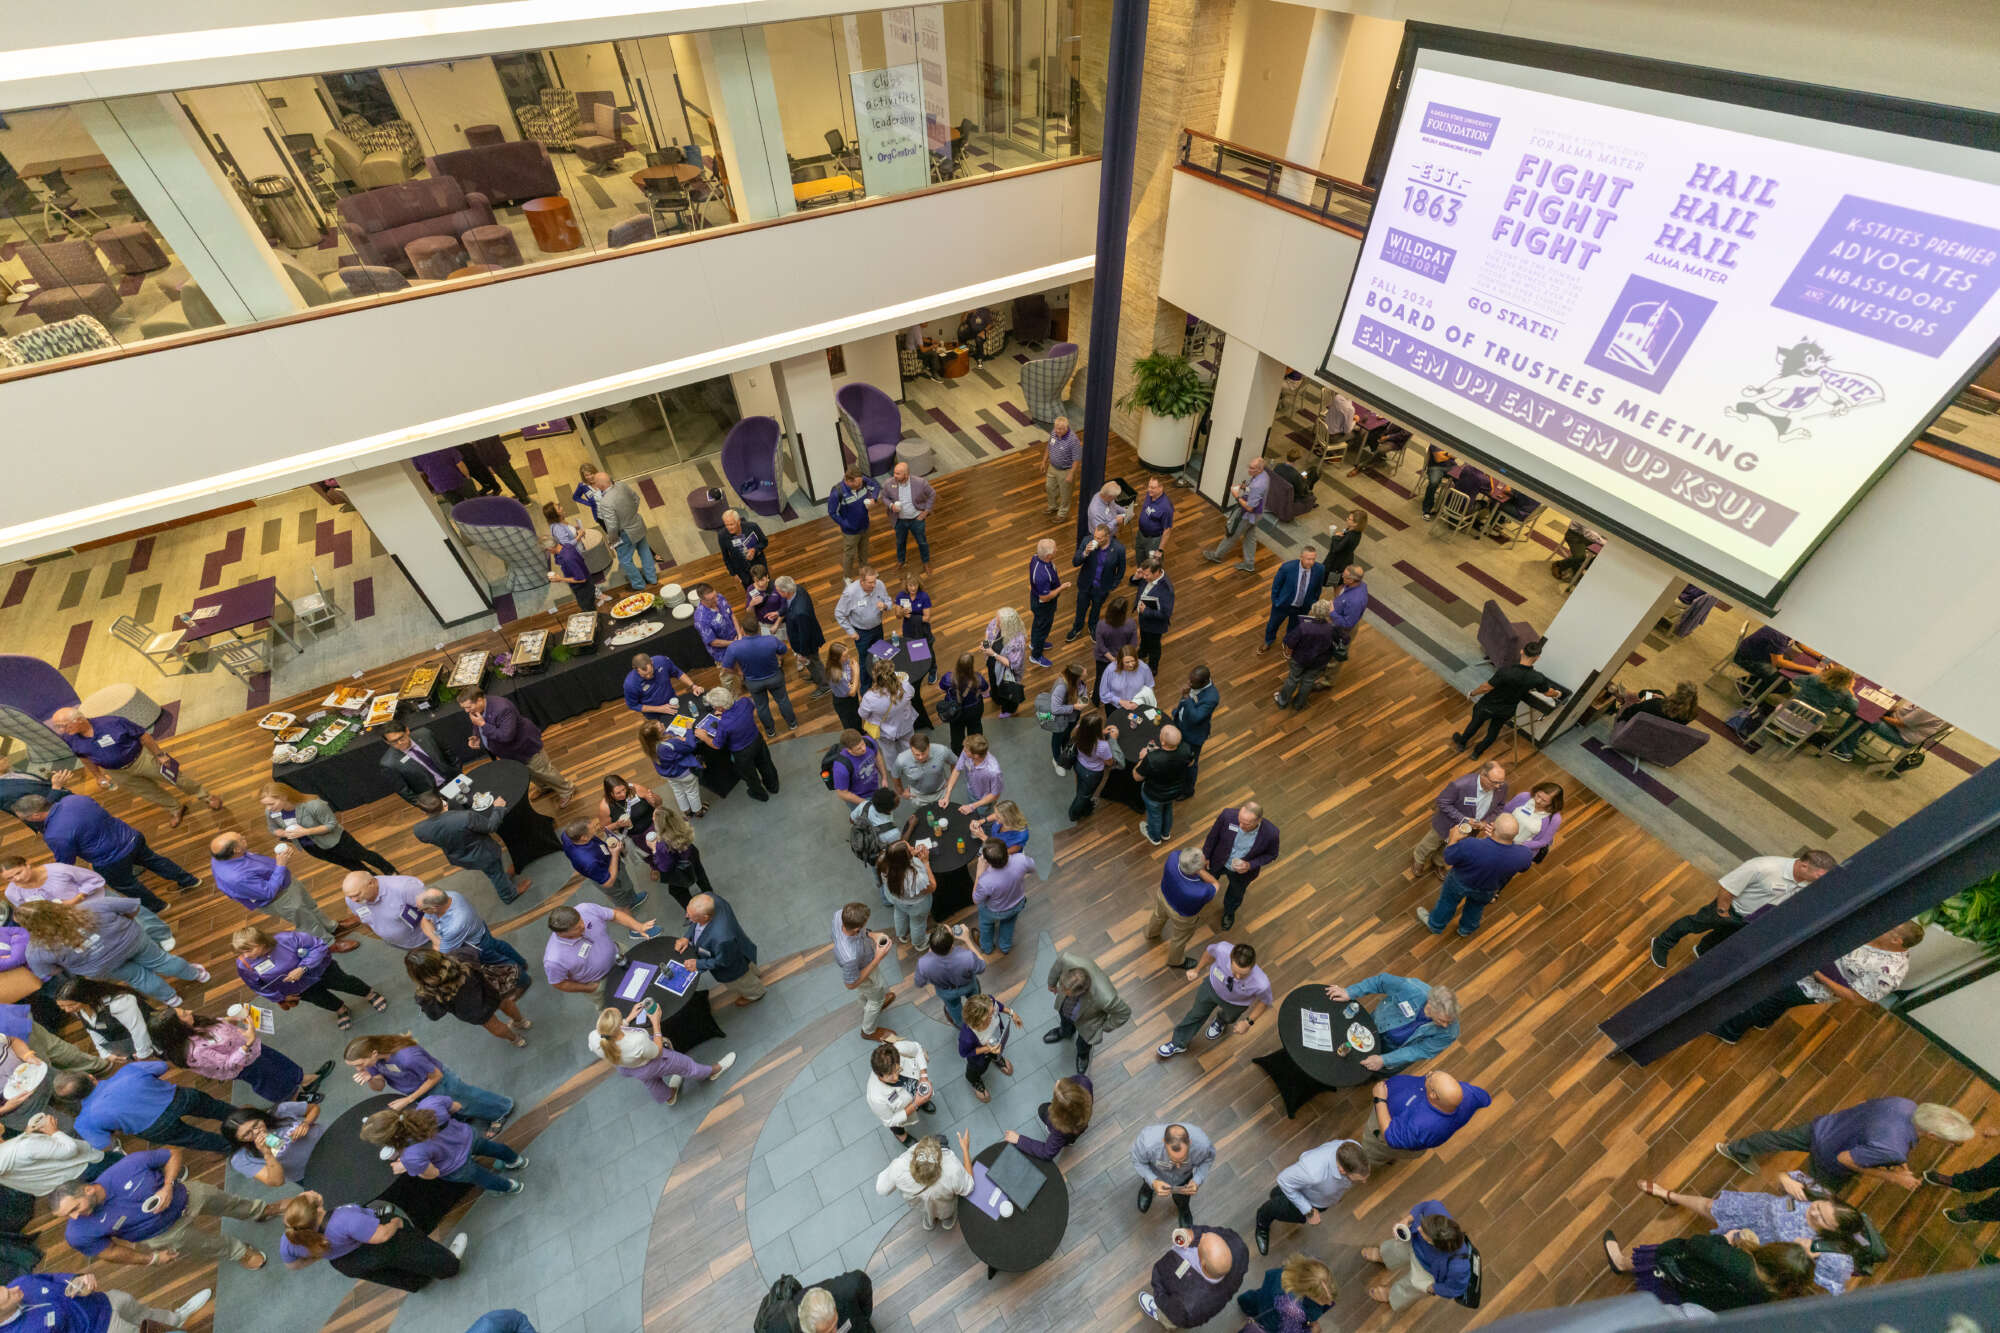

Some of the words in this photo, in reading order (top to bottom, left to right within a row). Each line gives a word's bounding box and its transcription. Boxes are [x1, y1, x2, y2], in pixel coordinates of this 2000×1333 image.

[1426, 118, 1490, 142] FOUNDATION
[1529, 135, 1554, 150] FOR
[1558, 143, 1593, 160] ALMA
[1598, 153, 1645, 172] MATER
[1515, 153, 1634, 209] FIGHT
[1685, 162, 1779, 208] HAIL
[1402, 185, 1464, 227] 1863
[1503, 184, 1618, 239] FIGHT
[1669, 193, 1759, 240] HAIL
[1390, 233, 1451, 266] WILDCAT
[1491, 214, 1602, 271] FIGHT
[1654, 223, 1741, 269] HAIL
[1924, 236, 1997, 267] PREMIER
[1645, 252, 1680, 270] ALMA
[1683, 263, 1728, 285] MATER
[1829, 240, 1979, 292] ADVOCATES
[1370, 276, 1397, 295] FALL
[1402, 289, 1433, 309] 2024
[1815, 264, 1957, 315] AMBASSADORS
[1468, 296, 1492, 314] GO
[1497, 308, 1559, 341] STATE!
[1828, 293, 1938, 337] INVESTORS
[1365, 290, 1435, 332] BOARD
[1445, 325, 1475, 348] OF
[1483, 340, 1606, 406] TRUSTEES
[1613, 399, 1760, 472] MEETING
[1358, 325, 1400, 357] EAT
[1452, 364, 1499, 404] UP!
[1500, 387, 1556, 429] EAT
[1622, 444, 1670, 481] UP
[1671, 467, 1767, 530] KSU!
